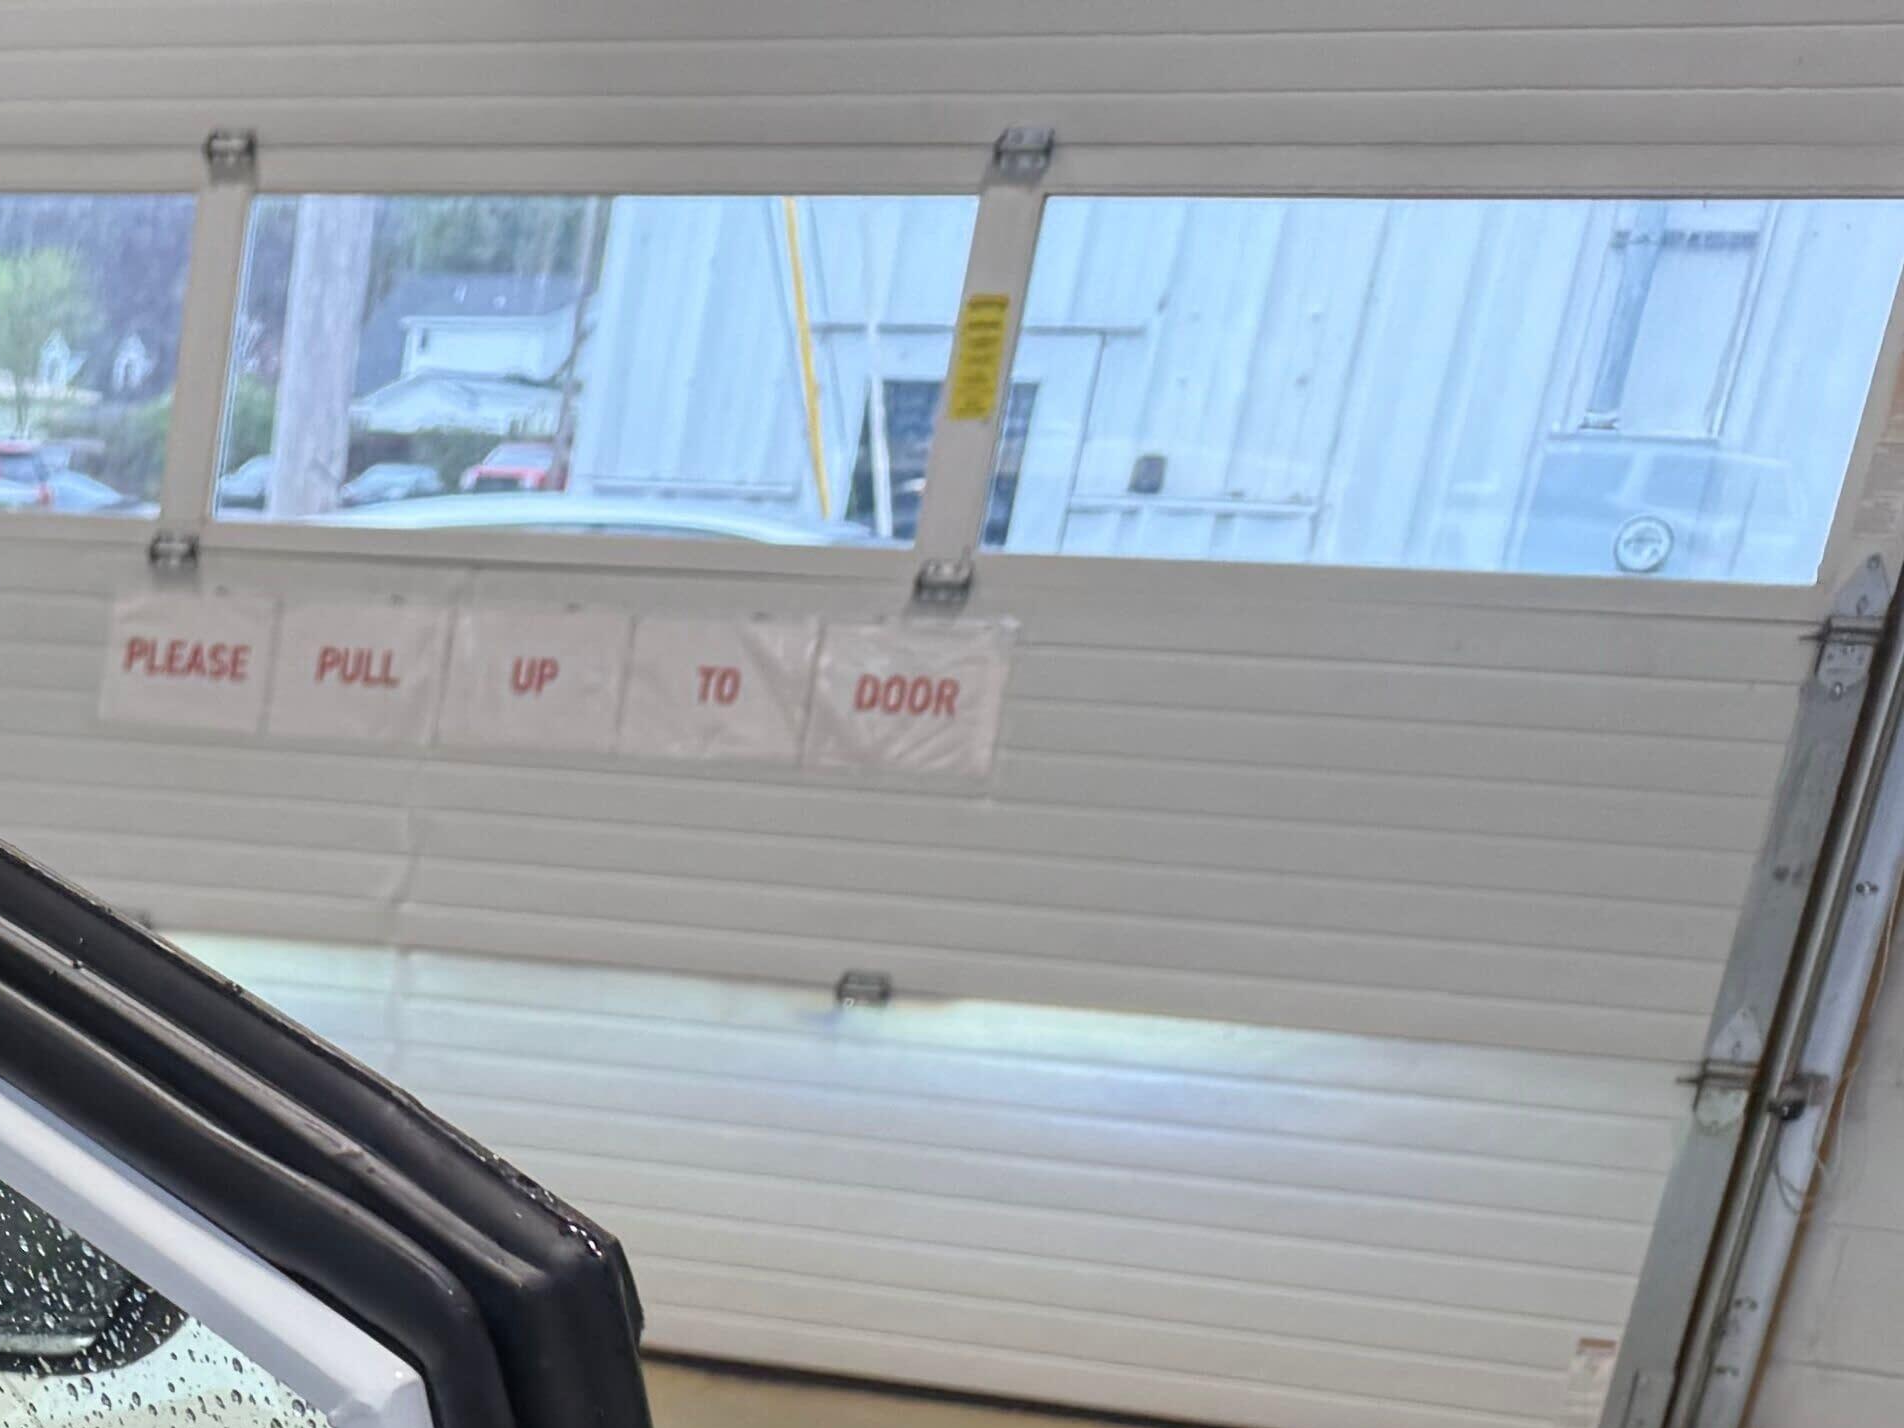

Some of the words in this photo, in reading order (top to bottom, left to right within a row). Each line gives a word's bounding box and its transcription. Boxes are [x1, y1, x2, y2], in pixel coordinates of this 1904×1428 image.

[123, 636, 251, 681] PLEASE
[314, 646, 400, 687] PULL
[510, 656, 559, 695] UP
[697, 664, 742, 705] TO
[854, 673, 960, 717] DOOR
